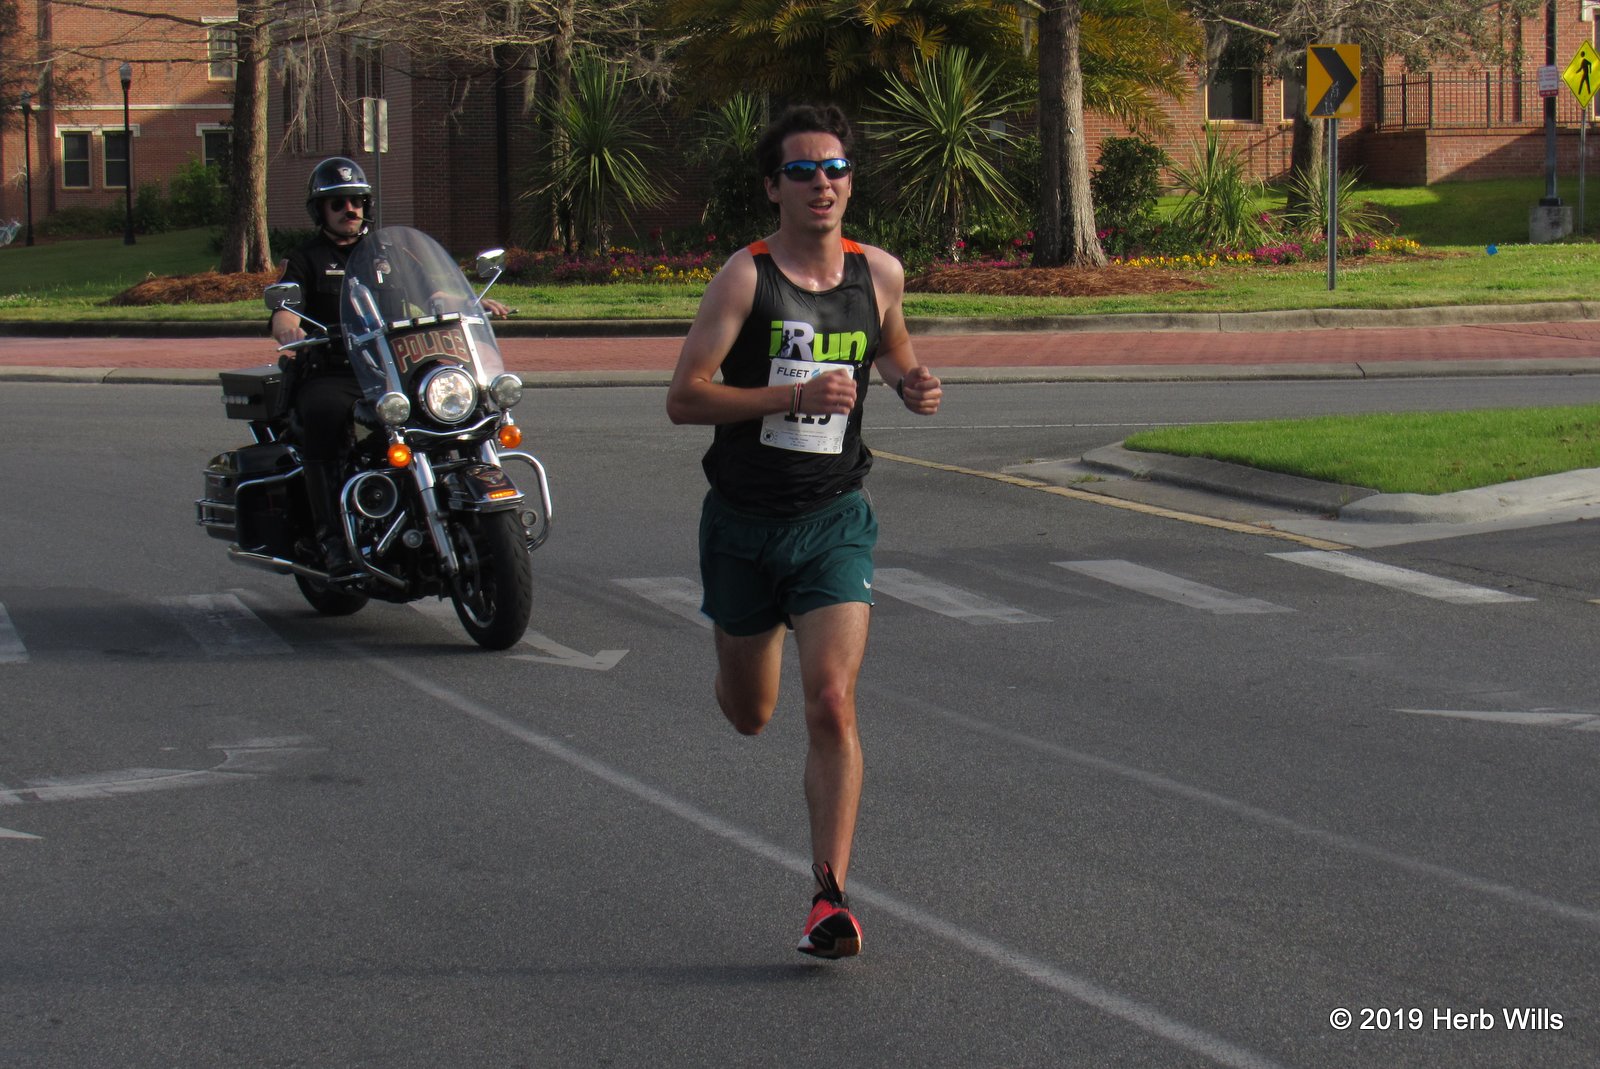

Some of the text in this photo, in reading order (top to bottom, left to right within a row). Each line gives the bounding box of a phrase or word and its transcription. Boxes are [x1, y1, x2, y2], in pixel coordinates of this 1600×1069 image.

[391, 329, 470, 373] POLICE
[769, 320, 868, 362] iRun
[777, 367, 810, 378] FLEET
